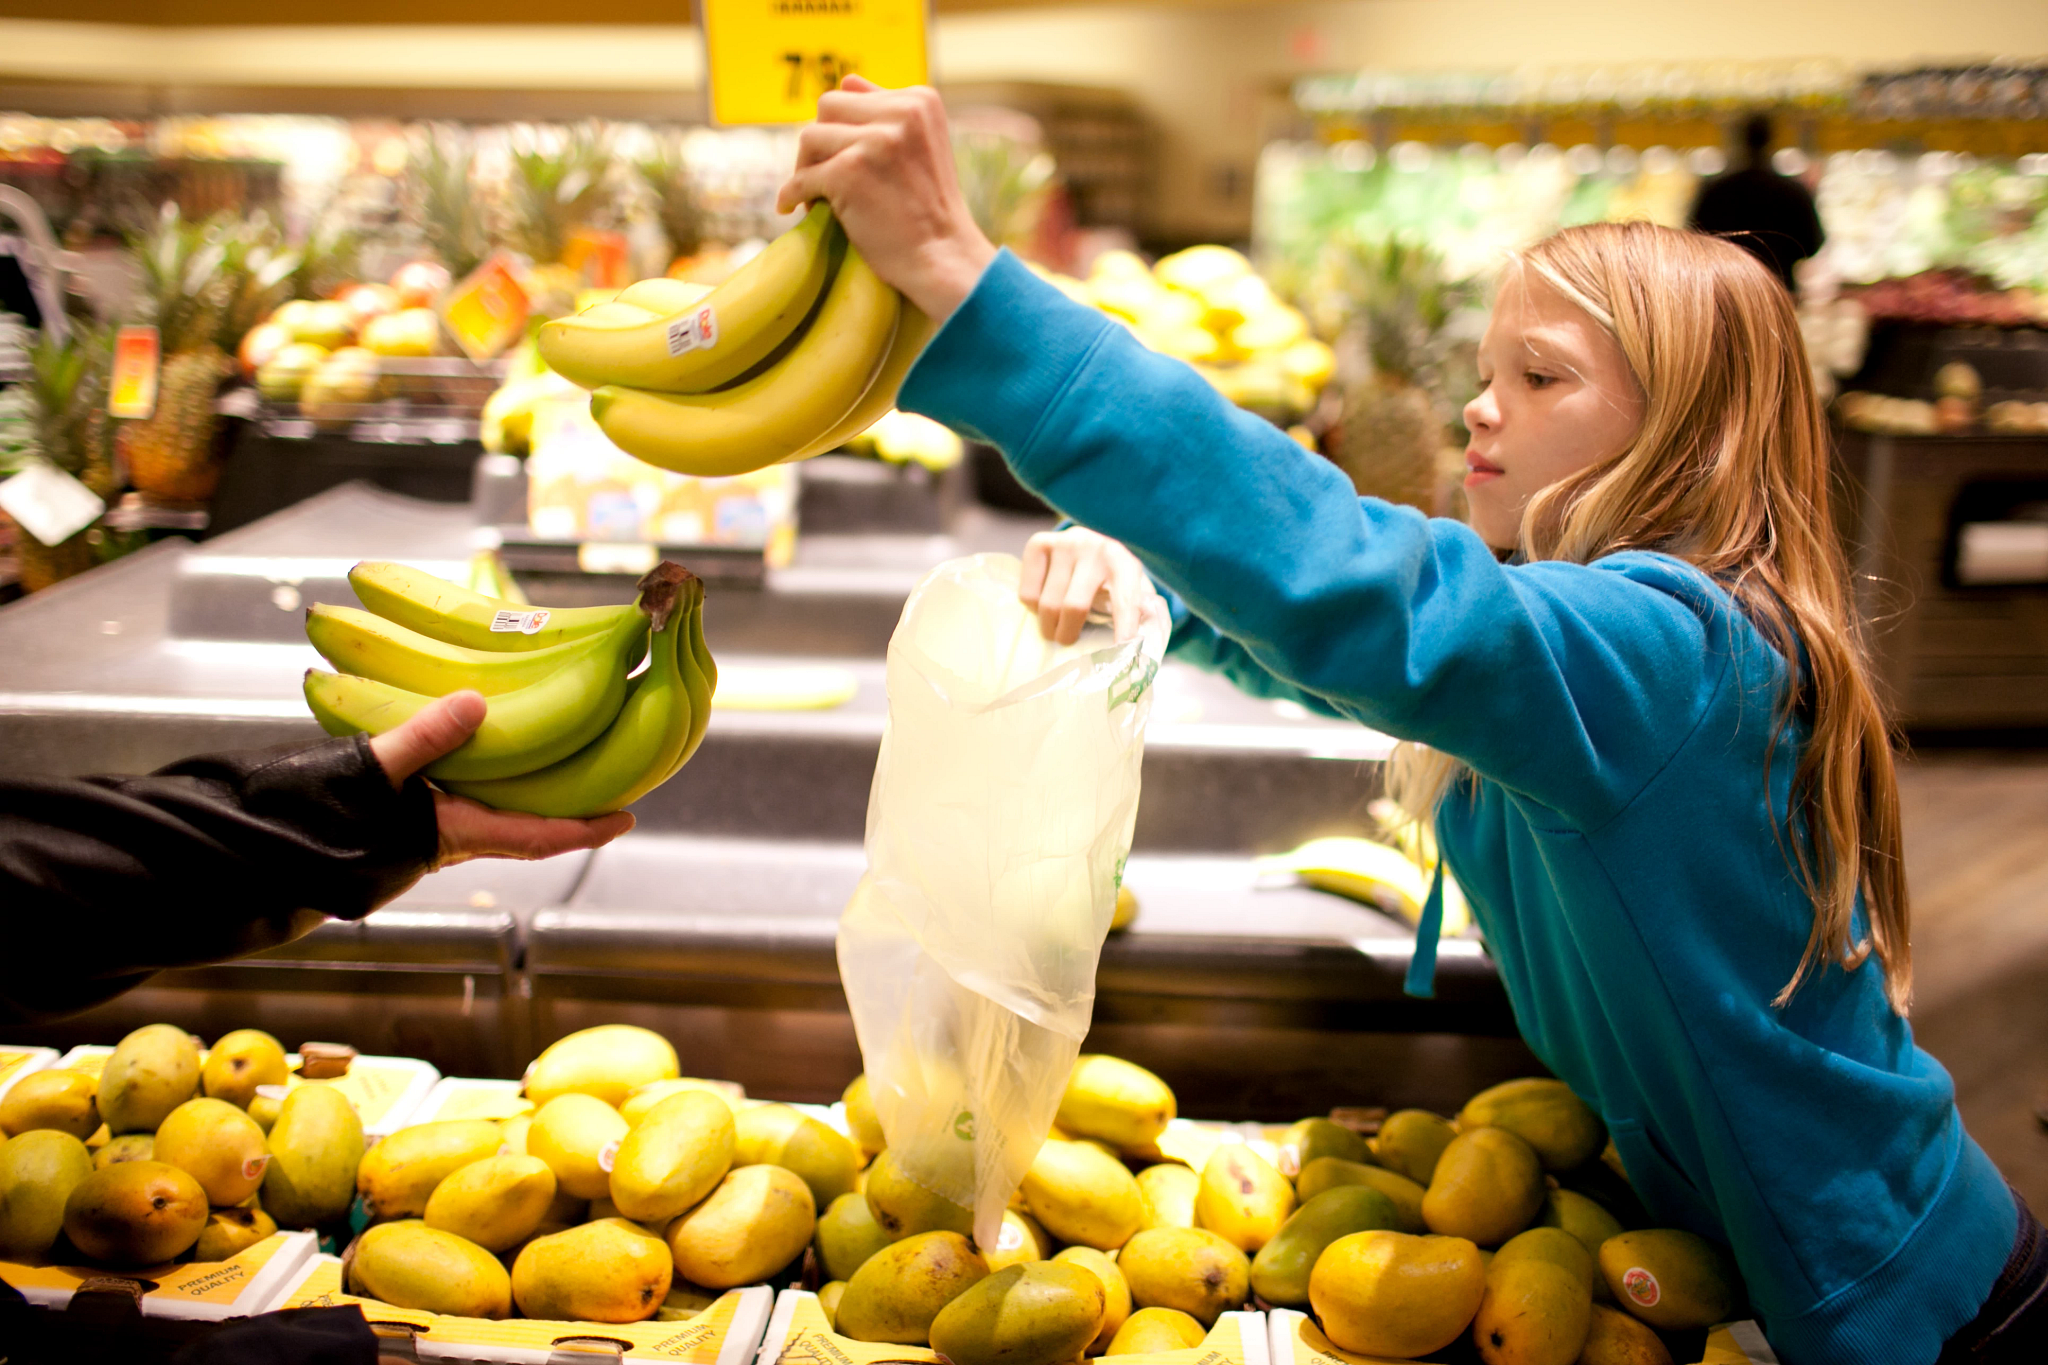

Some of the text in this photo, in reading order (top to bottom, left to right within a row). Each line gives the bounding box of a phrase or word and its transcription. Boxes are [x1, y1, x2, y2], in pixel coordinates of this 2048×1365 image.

[178, 1265, 241, 1291] PREMIUM
[191, 1272, 244, 1295] QUALITY
[652, 1324, 710, 1351] PREMIUM
[668, 1330, 716, 1356] QUALITY
